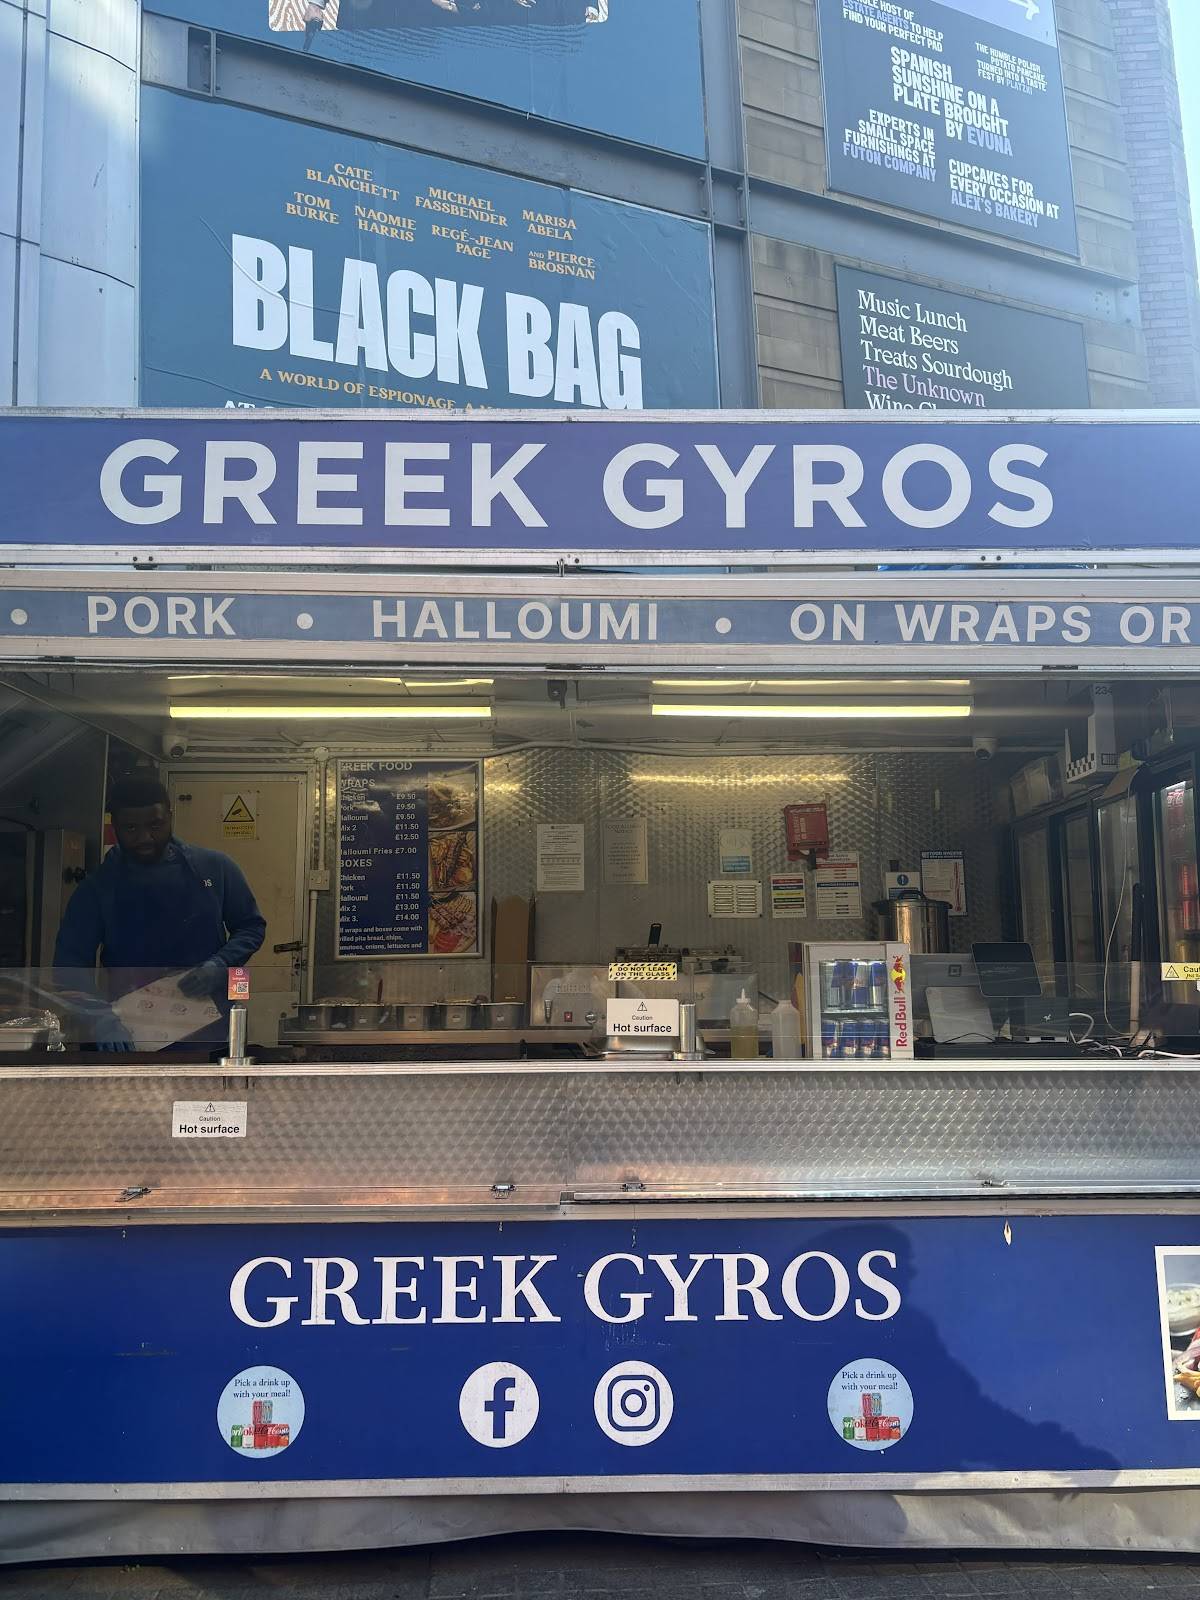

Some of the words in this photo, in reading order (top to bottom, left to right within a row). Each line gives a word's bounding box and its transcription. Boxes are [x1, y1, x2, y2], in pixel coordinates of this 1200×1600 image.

[880, 0, 902, 17] HOST
[904, 9, 914, 21] OF
[843, 8, 863, 24] FIND
[864, 16, 886, 32] YOUR
[888, 24, 926, 46] PERFECT
[928, 38, 942, 52] PAD
[877, 10, 910, 30] AGENTS
[910, 22, 922, 34] TO
[923, 26, 944, 42] HELP
[891, 46, 952, 83] SPANISH
[976, 42, 989, 54] THE
[990, 48, 1016, 64] HUMBLE
[991, 56, 1016, 72] POTATO
[977, 60, 1003, 76] TURNED
[1004, 70, 1020, 82] INTO
[1020, 76, 1026, 84] A
[978, 68, 994, 82] FEST
[996, 75, 1004, 86] BY
[892, 64, 964, 105] SUNSHINE
[968, 90, 986, 112] ON
[991, 97, 1000, 117] A
[893, 82, 940, 116] PLATE
[944, 100, 1008, 137] BROUGHT
[859, 120, 897, 143] SMALL
[900, 132, 936, 155] SPACE
[870, 109, 920, 137] EXPERTS
[923, 126, 934, 141] IN
[945, 118, 964, 140] BY
[966, 125, 1013, 156] EVUNA
[845, 128, 920, 163] FURNISHINGS
[923, 152, 936, 168] AT
[334, 163, 374, 182] CATE
[843, 142, 881, 166] FUTON
[884, 154, 936, 182] COMPANY
[306, 168, 400, 201] BLANCHETT
[949, 159, 1009, 190] CUPCAKES
[1011, 177, 1034, 197] FOR
[294, 192, 330, 210] TOM
[428, 186, 495, 212] MICHAEL
[950, 174, 987, 198] EVERY
[989, 186, 1044, 215] OCCASION
[1046, 203, 1060, 219] AT
[951, 190, 992, 215] ALEX'S
[995, 202, 1038, 228] BAKERY
[286, 203, 339, 224] BURKE
[354, 206, 416, 230] NAOMIE
[415, 196, 508, 227] FASSBENDER
[522, 210, 577, 230] MARISA
[358, 219, 414, 242] HARRIS
[432, 224, 514, 252] REGÉ-JEAN
[527, 223, 573, 241] ABELA
[456, 242, 491, 259] PAGE
[547, 250, 596, 268] PIERCE
[529, 258, 596, 280] BROSNAN
[232, 233, 488, 390] BLACK
[506, 291, 644, 409] BAG
[858, 289, 911, 320] Music
[915, 302, 968, 333] Lunch
[859, 315, 905, 343] Meat
[910, 326, 959, 355] Beers
[860, 339, 918, 370] Treats
[922, 353, 1014, 392] Sourdough
[259, 368, 272, 381] A
[278, 370, 339, 391] WORLD
[344, 382, 364, 395] OF
[863, 364, 898, 390] The
[902, 373, 986, 408] Unknown
[100, 438, 549, 528] GREEK
[602, 442, 1054, 530] GYROS
[88, 596, 236, 636] PORK
[373, 600, 657, 641] HALLOUMI
[790, 602, 866, 642] ON
[894, 603, 1092, 643] WRAPS
[1119, 605, 1192, 644] OR
[380, 762, 413, 771] FOOD
[894, 996, 906, 1020] Bull
[613, 1024, 630, 1032] Hot
[634, 1024, 672, 1032] surface
[895, 1023, 907, 1047] Red
[180, 1124, 197, 1133] Hot
[200, 1124, 240, 1133] surface
[229, 1254, 562, 1329] GREEK
[583, 1250, 901, 1326] GYROS
[252, 1391, 268, 1400] your
[841, 1382, 858, 1390] with
[860, 1384, 876, 1392] your
